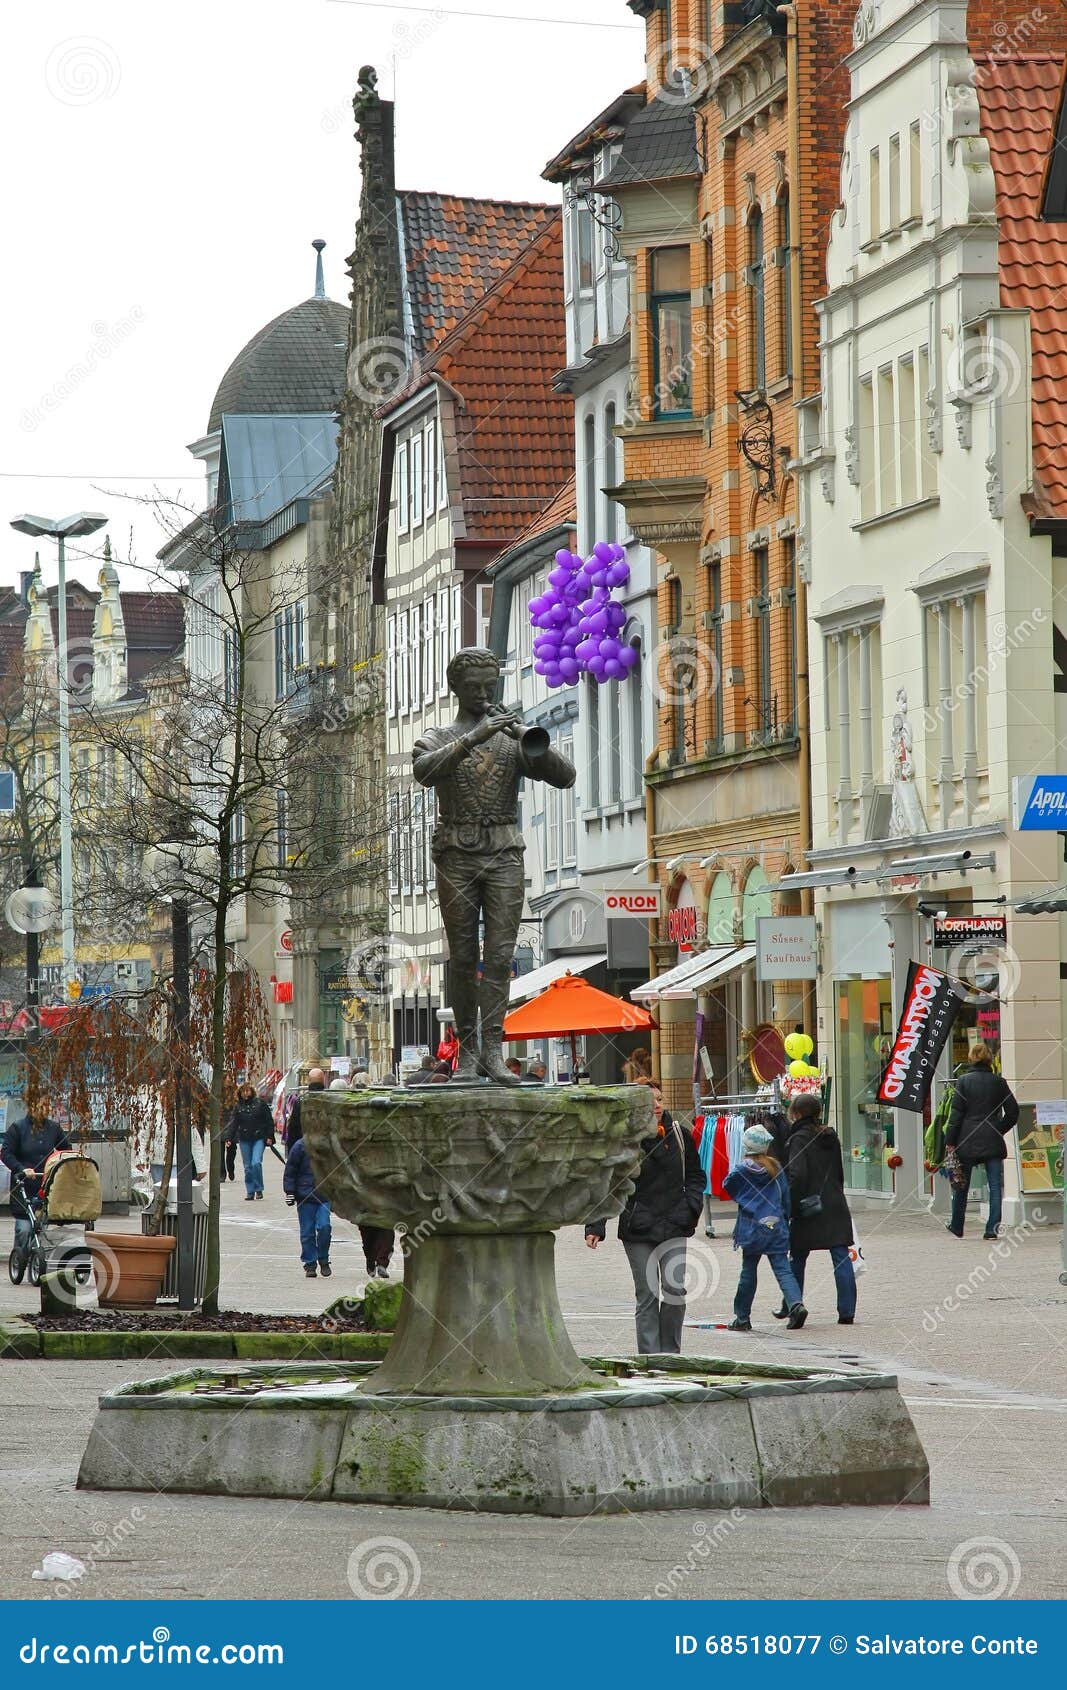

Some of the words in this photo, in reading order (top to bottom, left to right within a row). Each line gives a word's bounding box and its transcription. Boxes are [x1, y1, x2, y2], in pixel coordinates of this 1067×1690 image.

[1030, 787, 1067, 809] APOL
[607, 896, 657, 912] ORION
[668, 906, 697, 944] ORION
[936, 920, 1004, 932] NORTHLAND
[766, 953, 812, 963] Kaufhaus
